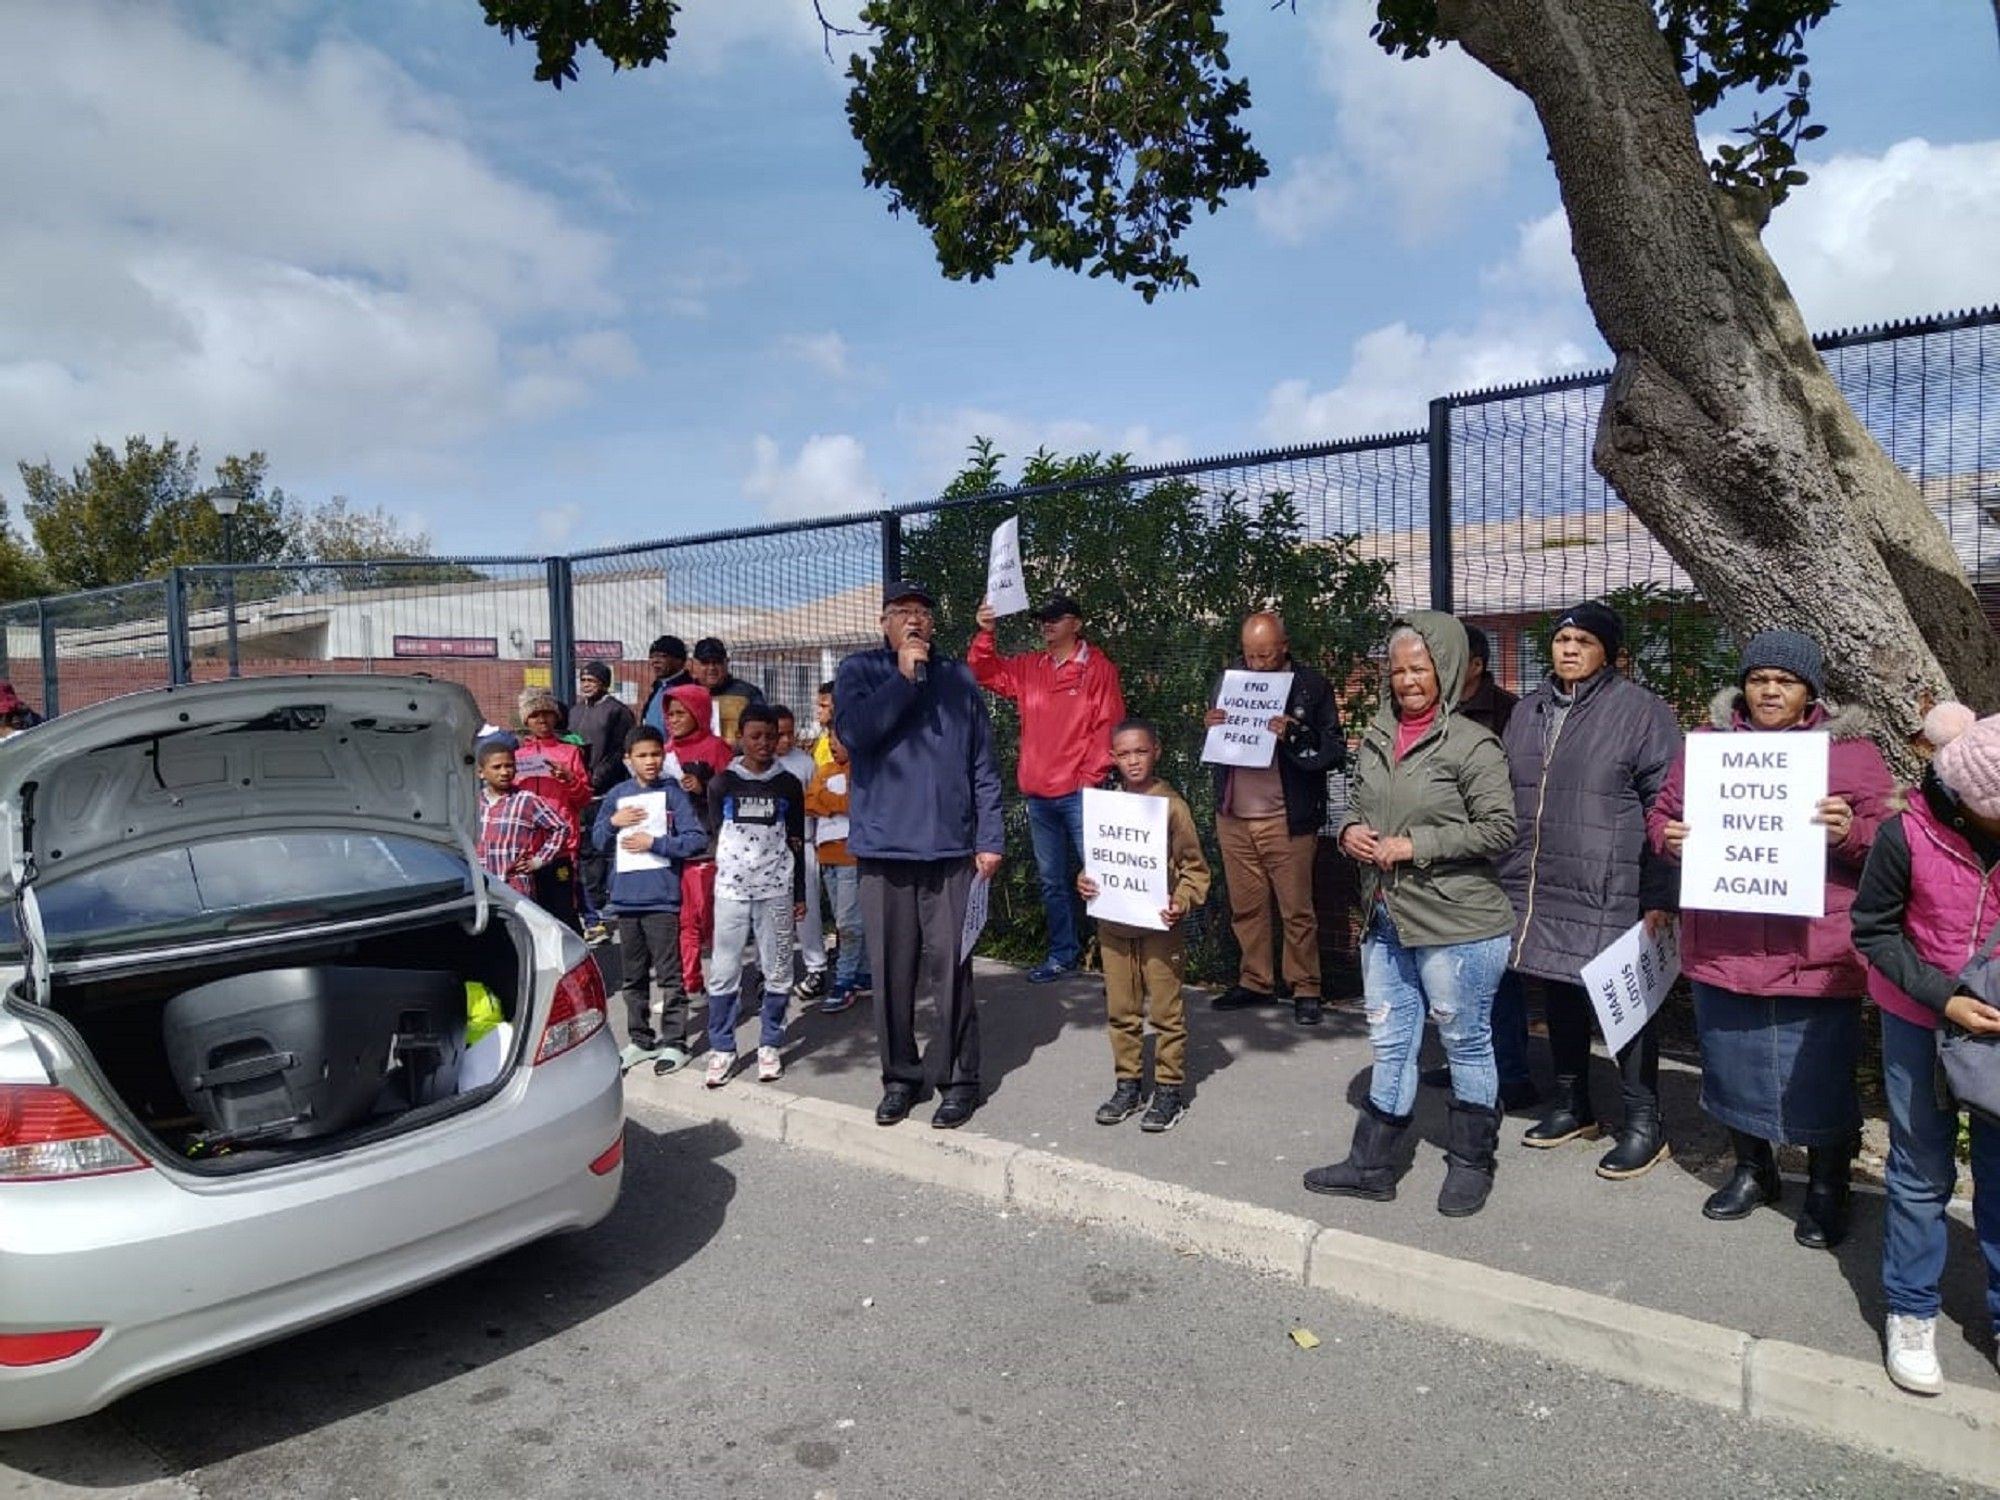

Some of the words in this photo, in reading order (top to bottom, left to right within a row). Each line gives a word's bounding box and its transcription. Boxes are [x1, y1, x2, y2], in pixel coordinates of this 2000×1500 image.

[1244, 682, 1269, 693] END
[1223, 697, 1283, 711] VIOLENCE,
[1227, 715, 1249, 727] EEP
[1253, 717, 1268, 728] TH
[1722, 752, 1788, 769] MAKE
[1720, 783, 1788, 800] LOTUS
[1722, 814, 1784, 831] RIVER
[1099, 824, 1150, 844] SAFETY
[1092, 847, 1157, 869] BELONGS
[1725, 845, 1779, 864] SAFE
[1101, 873, 1119, 888] TO
[1123, 877, 1149, 892] ALL
[1714, 877, 1788, 896] AGAIN
[1621, 963, 1641, 1009] LOTUS
[1602, 978, 1625, 1026] MAKE
